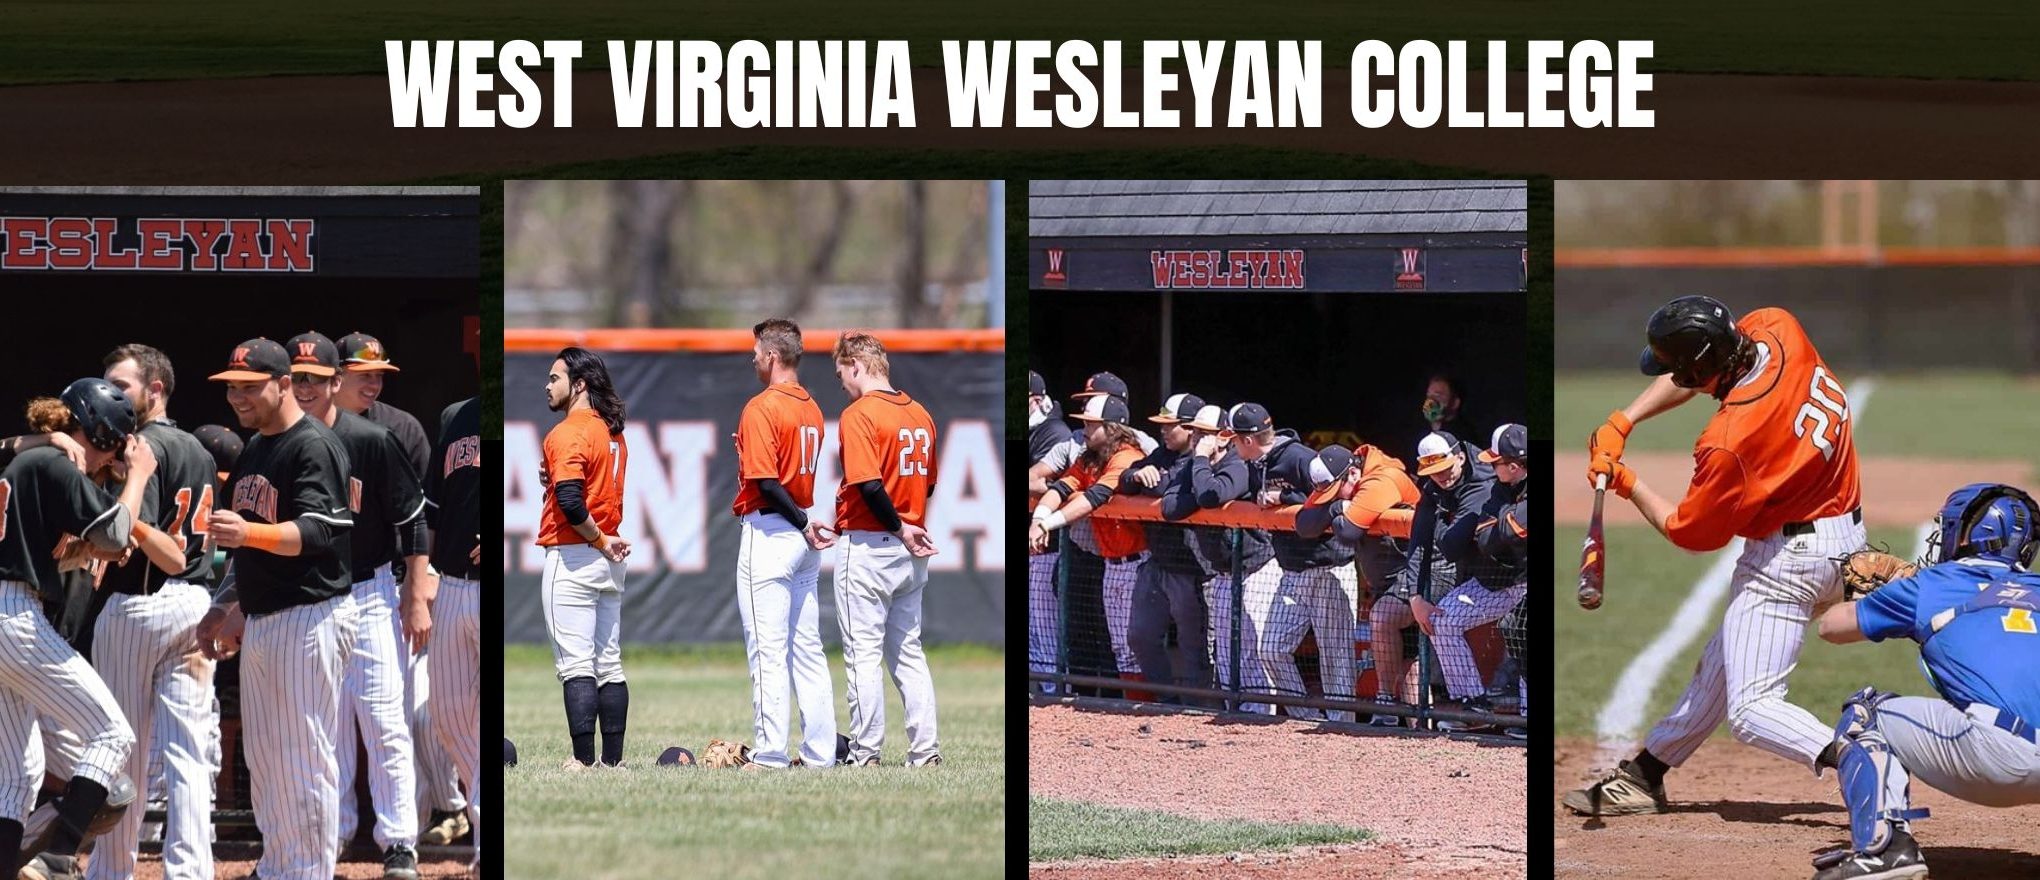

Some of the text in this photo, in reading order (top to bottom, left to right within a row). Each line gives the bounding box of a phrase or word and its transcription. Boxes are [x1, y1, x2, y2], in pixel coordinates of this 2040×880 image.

[0, 217, 314, 271] ESLEYAN
[1048, 250, 1064, 272] W
[1402, 249, 1418, 273] W
[1151, 250, 1304, 288] WESLEYAN
[298, 342, 316, 356] W
[1793, 365, 1848, 462] 20
[609, 441, 620, 487] 7
[799, 425, 819, 475] 10
[899, 428, 931, 476] 23
[167, 484, 214, 552] 14
